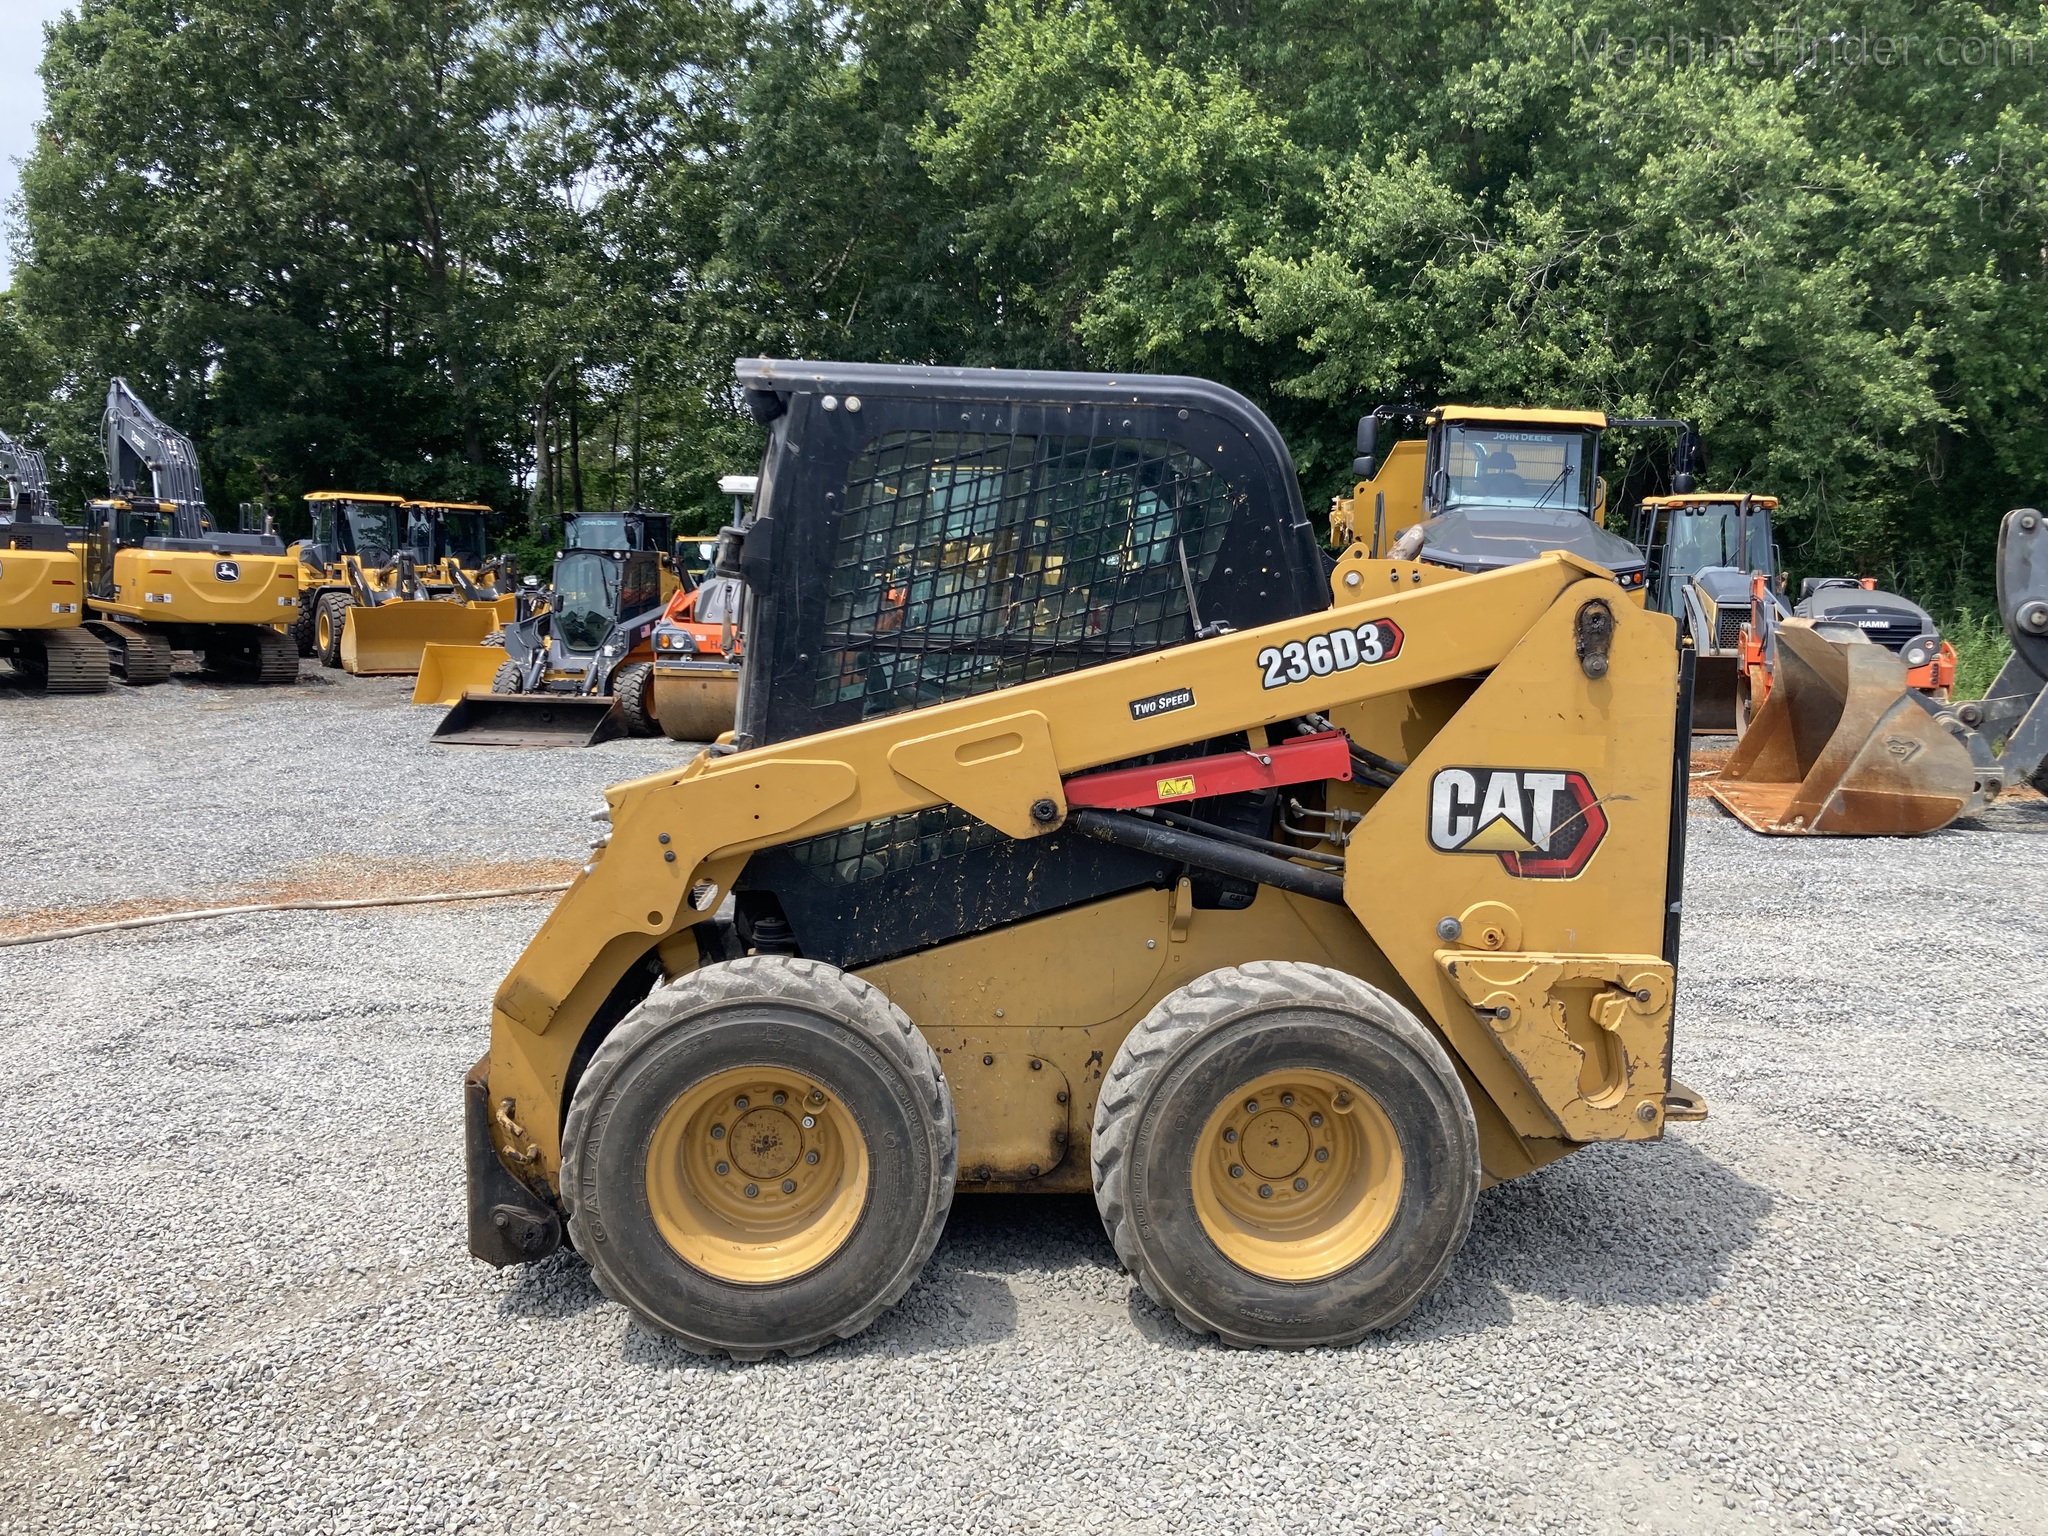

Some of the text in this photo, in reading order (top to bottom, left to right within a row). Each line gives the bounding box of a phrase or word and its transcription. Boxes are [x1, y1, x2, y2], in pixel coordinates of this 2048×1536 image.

[1521, 433, 1553, 442] DEERE
[1258, 623, 1385, 689] 236D3
[1431, 769, 1566, 852] CAT
[833, 1026, 897, 1083] SUPER
[582, 1080, 623, 1242] GALAXY
